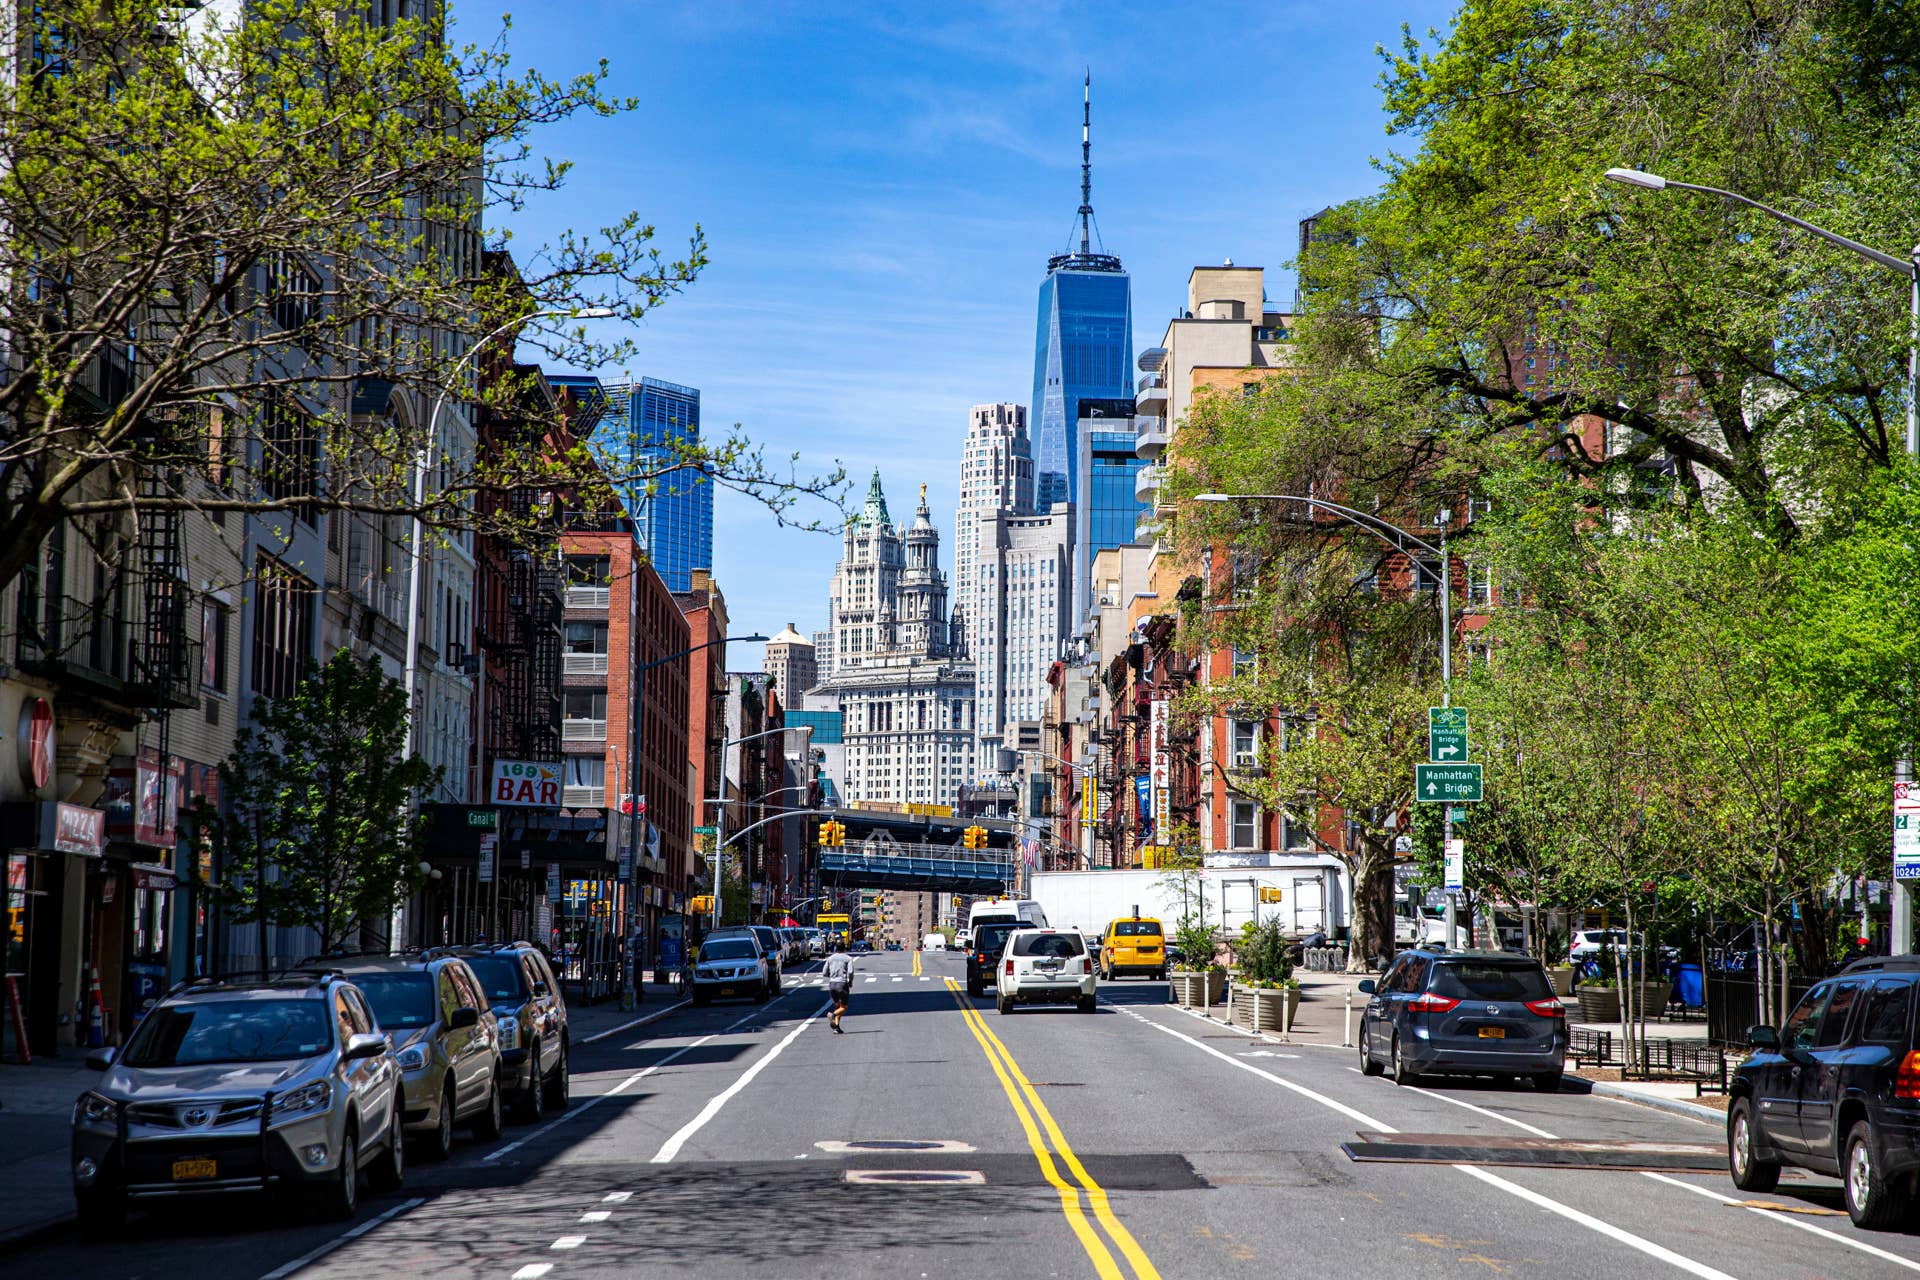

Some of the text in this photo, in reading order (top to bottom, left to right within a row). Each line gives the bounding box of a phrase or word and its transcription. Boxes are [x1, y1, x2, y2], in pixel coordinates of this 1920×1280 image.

[502, 763, 538, 779] 169
[1426, 771, 1473, 780] Manhattan
[496, 778, 559, 805] BAR
[1445, 783, 1473, 793] Bridge
[61, 808, 96, 842] PIZZA
[468, 812, 489, 825] Canal
[1897, 816, 1905, 828] 2
[141, 977, 154, 996] P
